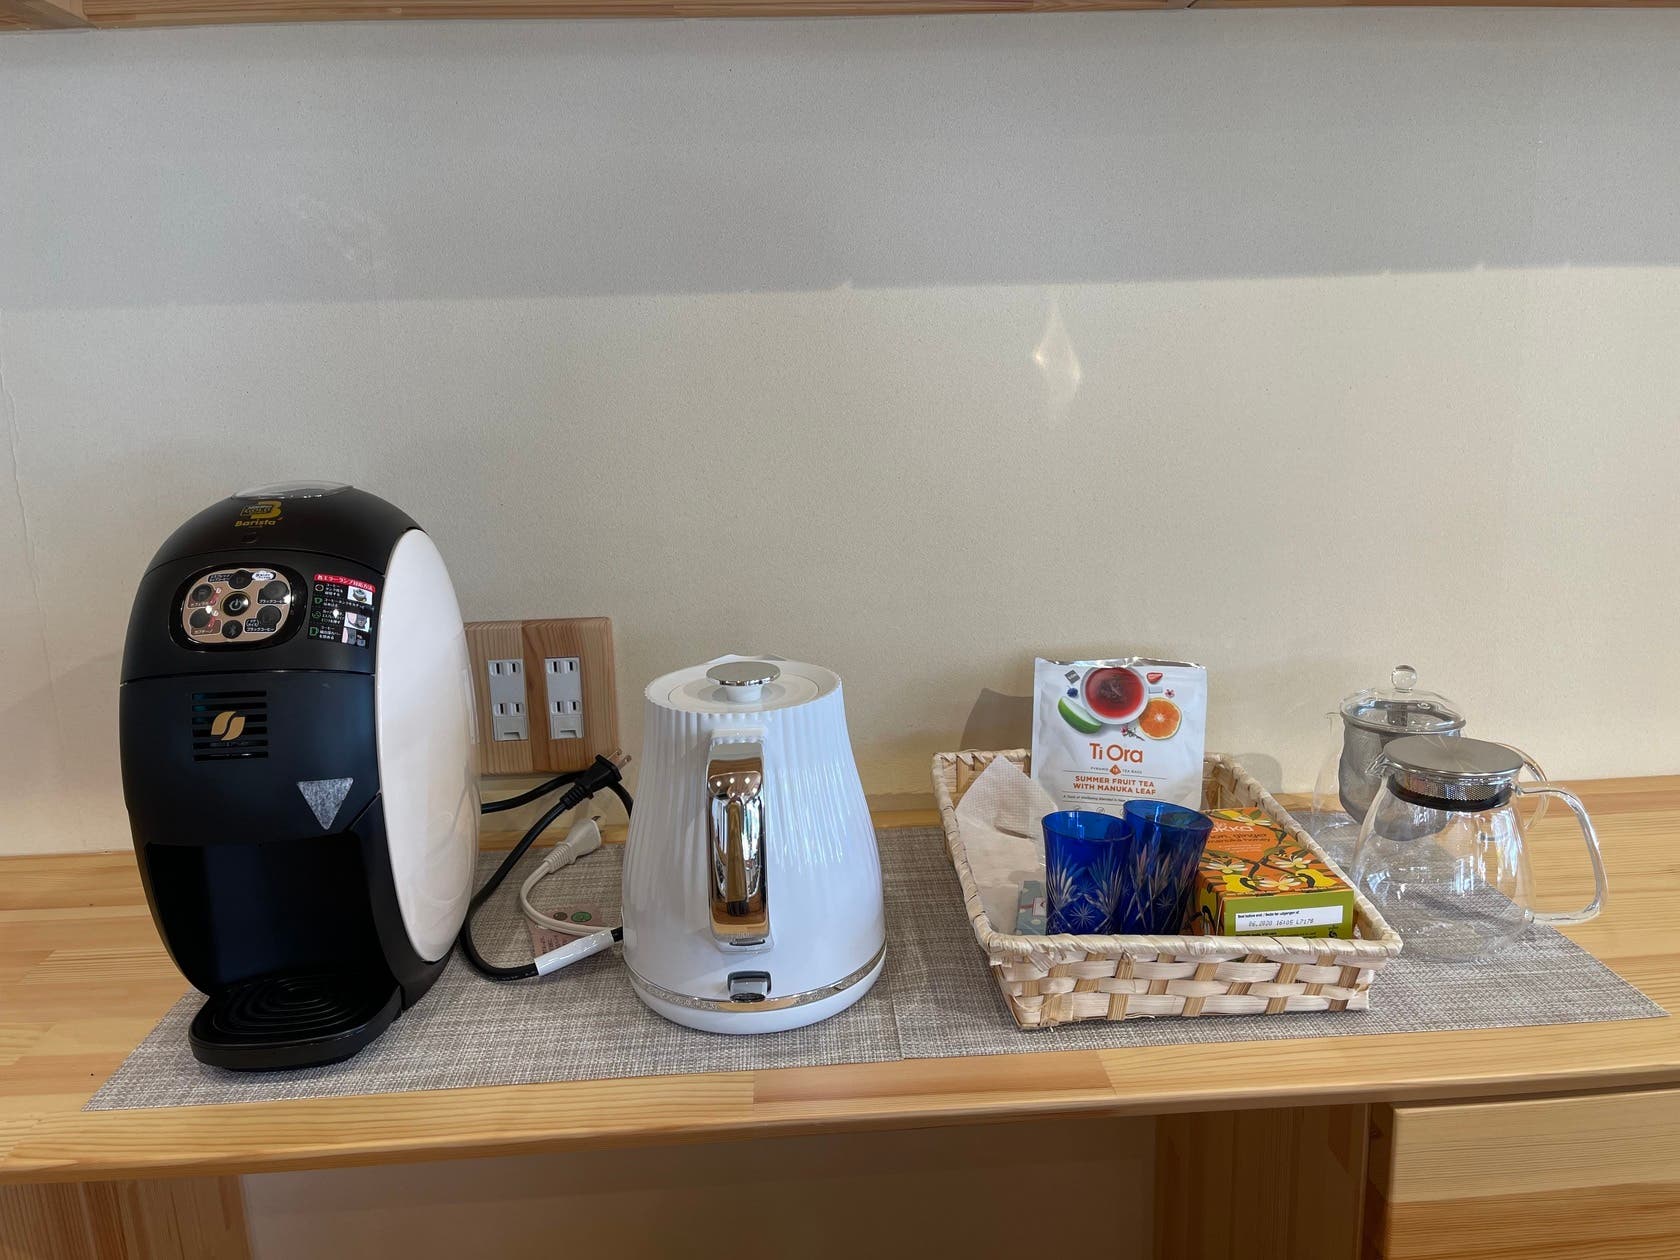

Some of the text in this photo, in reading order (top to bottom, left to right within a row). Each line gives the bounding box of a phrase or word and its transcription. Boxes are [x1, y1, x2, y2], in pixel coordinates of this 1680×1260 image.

[234, 519, 277, 527] Barista
[1089, 743, 1143, 763] Ti Ora
[1075, 775, 1110, 784] SUMMER
[1112, 778, 1136, 786] FRUIT
[1097, 784, 1133, 793] MANUKA
[1135, 788, 1157, 796] LEAF
[1248, 920, 1273, 928] 06.2020
